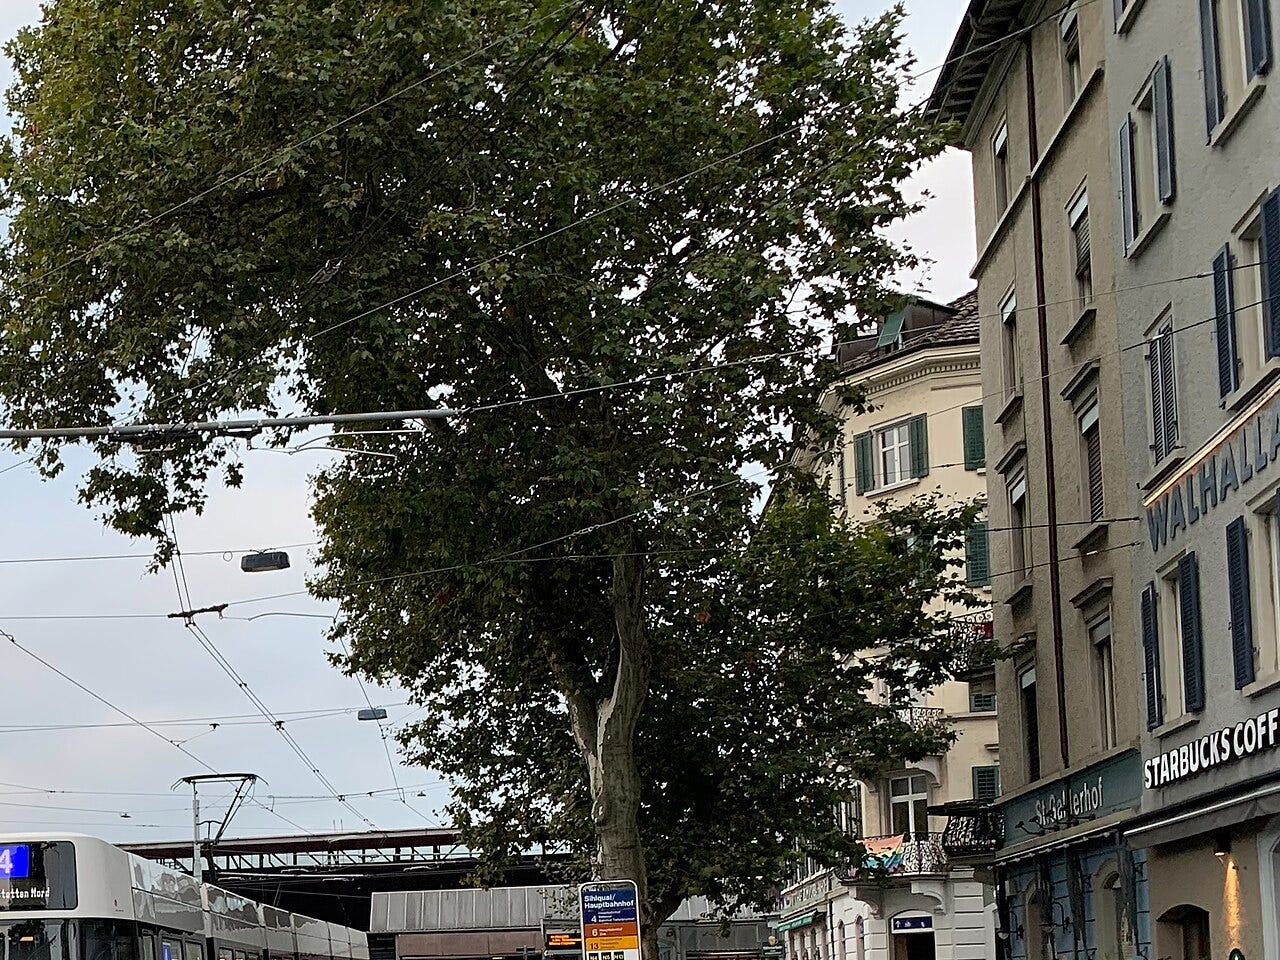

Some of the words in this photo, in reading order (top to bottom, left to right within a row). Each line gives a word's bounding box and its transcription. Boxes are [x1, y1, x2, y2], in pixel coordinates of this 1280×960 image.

[1144, 728, 1230, 789] STARBUCKS
[1233, 708, 1279, 756] COFF
[31, 887, 50, 898] Nord
[585, 900, 634, 909] Hauptbahnhof
[591, 915, 597, 923] 4
